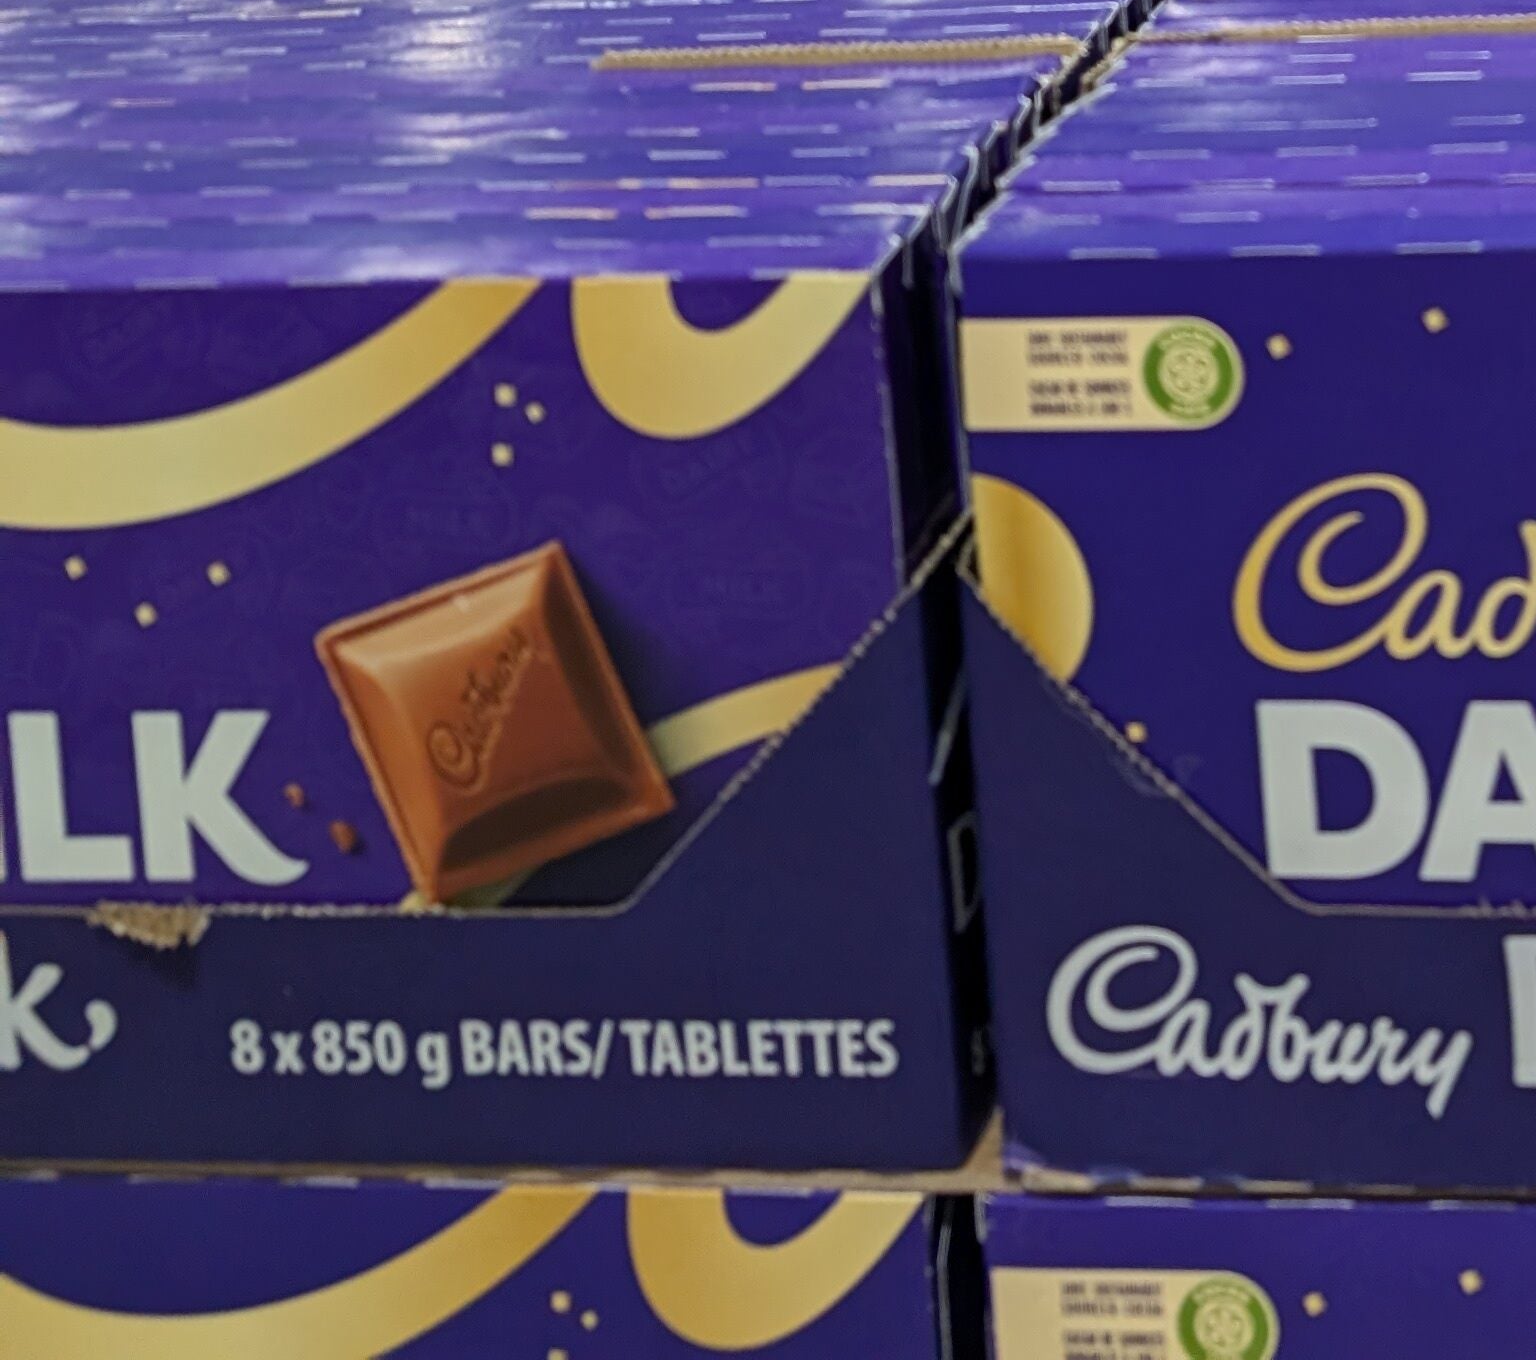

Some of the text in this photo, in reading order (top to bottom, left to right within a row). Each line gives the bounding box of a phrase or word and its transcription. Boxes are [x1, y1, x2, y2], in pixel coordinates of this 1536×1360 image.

[230, 1017, 899, 1090] 8 x 850 g BARS/ TABLETTES
[1044, 925, 1473, 1120] Cadbury
